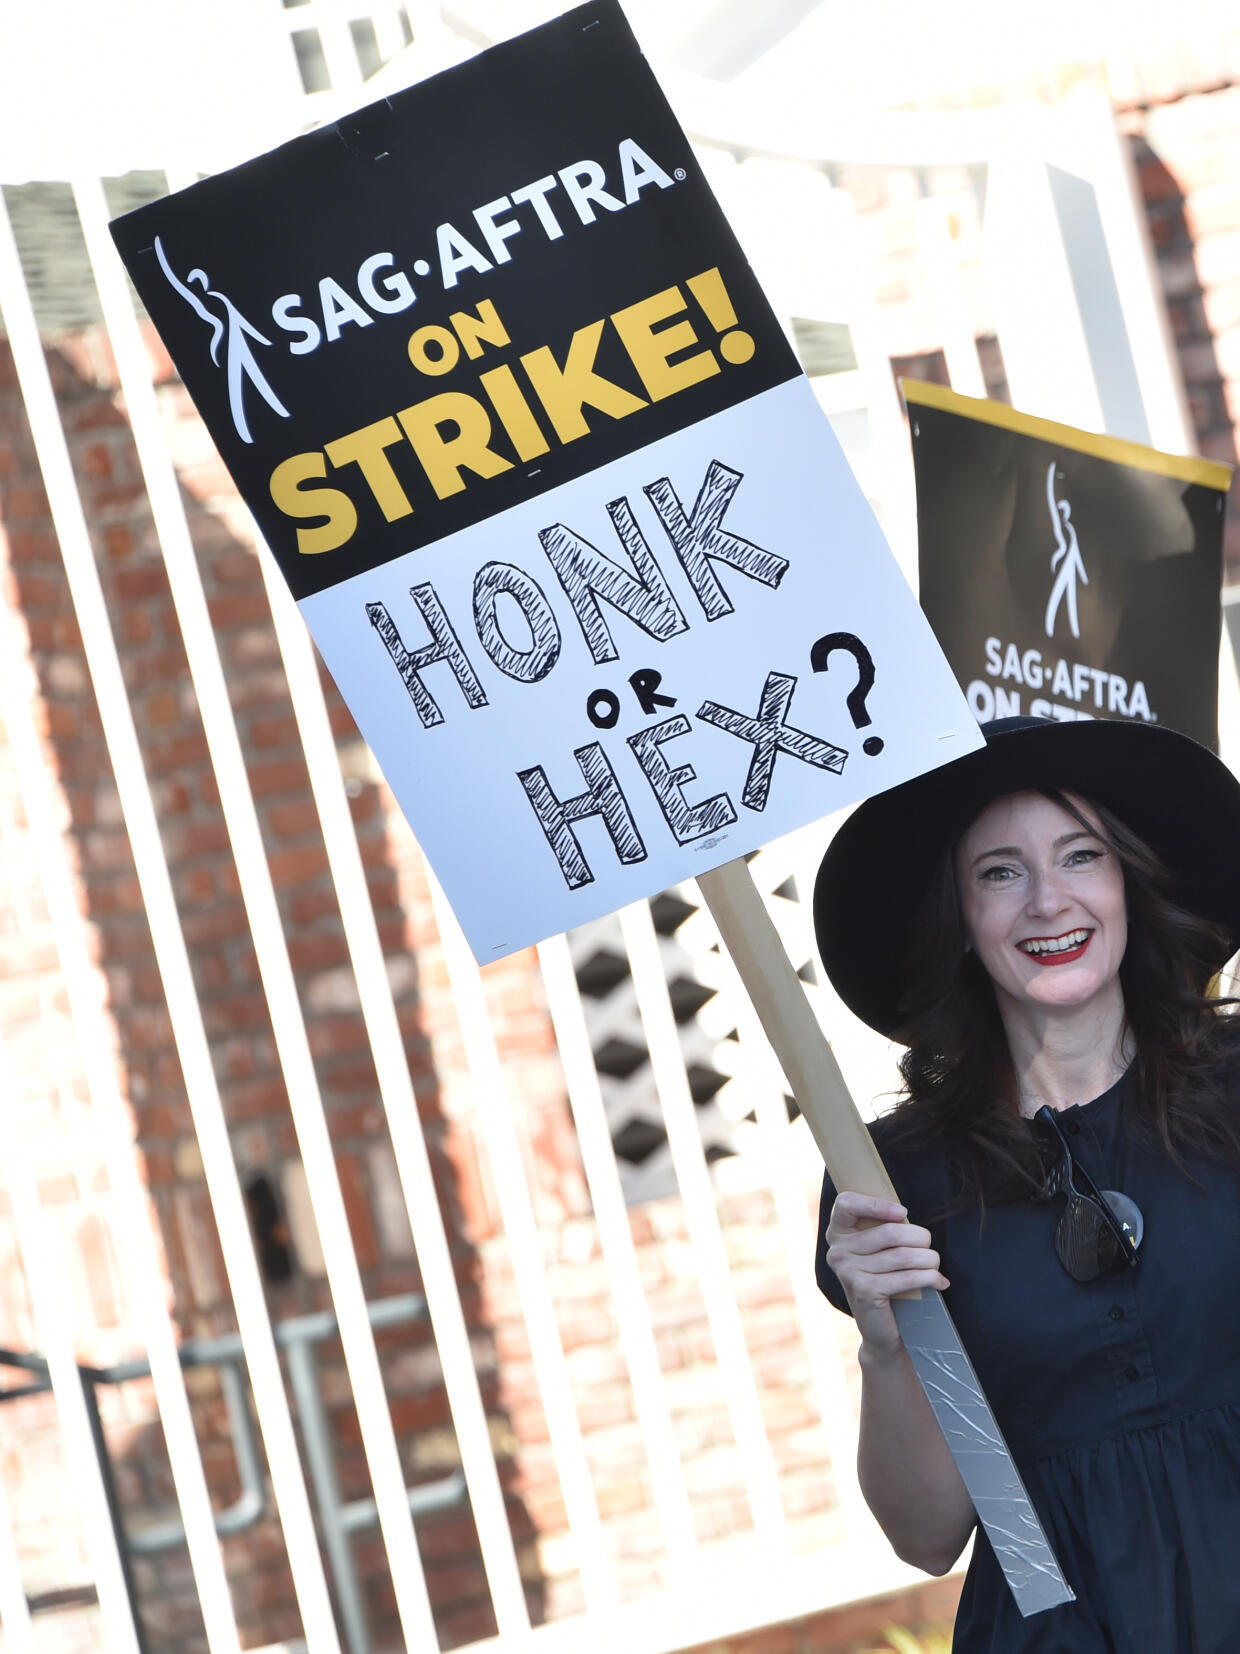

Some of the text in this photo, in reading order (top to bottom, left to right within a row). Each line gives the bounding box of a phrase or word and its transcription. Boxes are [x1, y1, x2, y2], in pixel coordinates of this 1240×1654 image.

[269, 267, 756, 555] STRIKE!
[408, 299, 512, 376] ON
[365, 459, 790, 729] HONK
[587, 669, 677, 729] OR
[517, 631, 884, 890] HEX?
